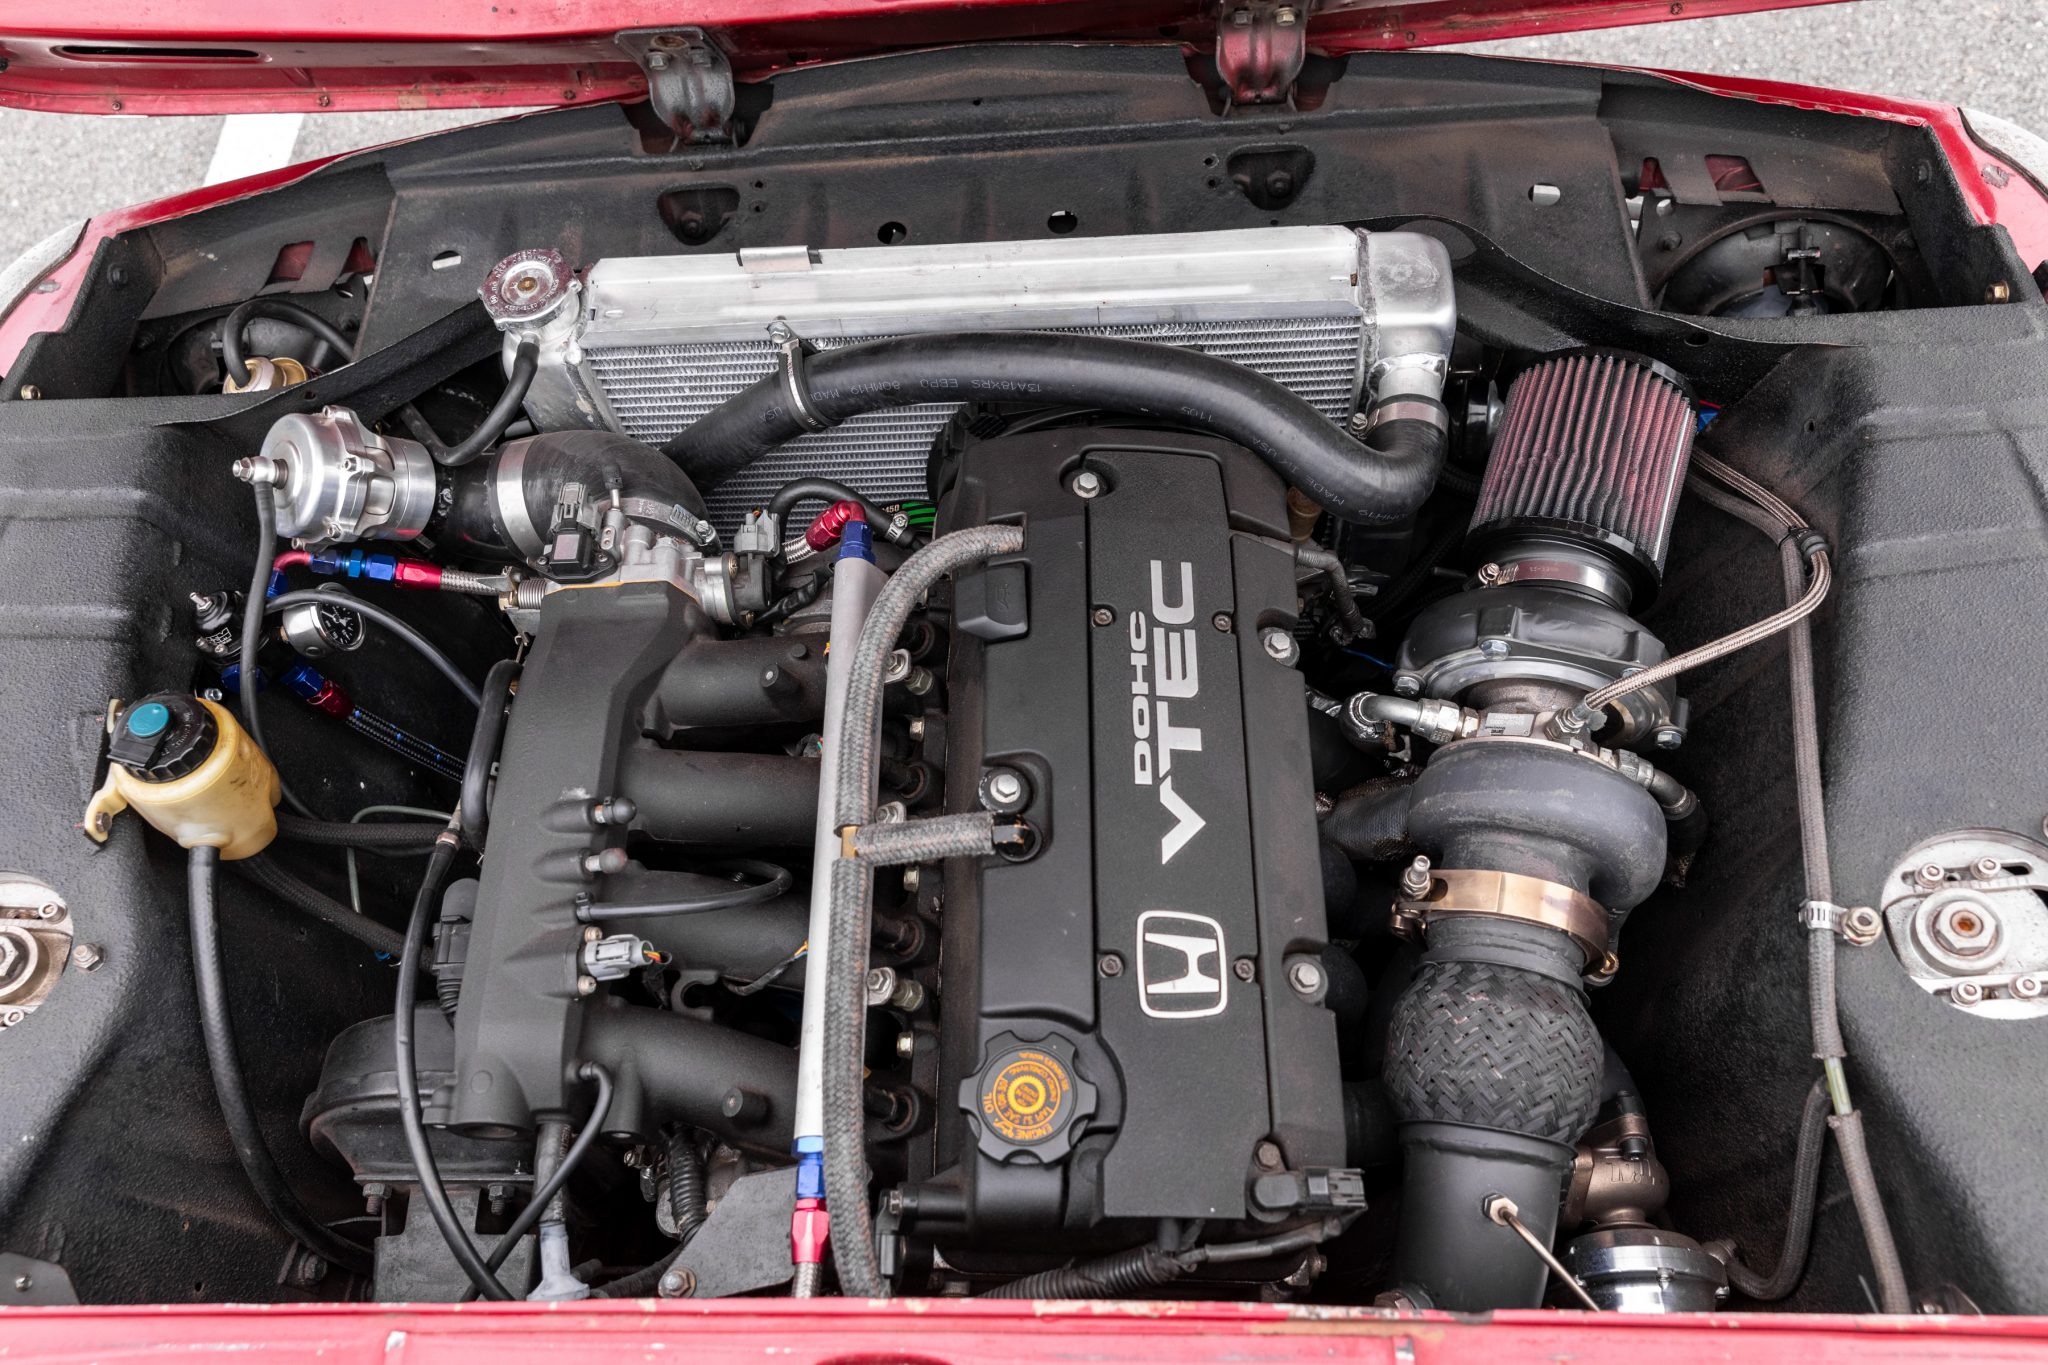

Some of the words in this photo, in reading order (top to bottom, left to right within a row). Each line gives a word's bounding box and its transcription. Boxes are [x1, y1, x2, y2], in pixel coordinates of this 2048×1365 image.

[1130, 611, 1152, 784] DOHC
[1150, 559, 1206, 865] VTEC
[983, 1092, 995, 1114] OIL
